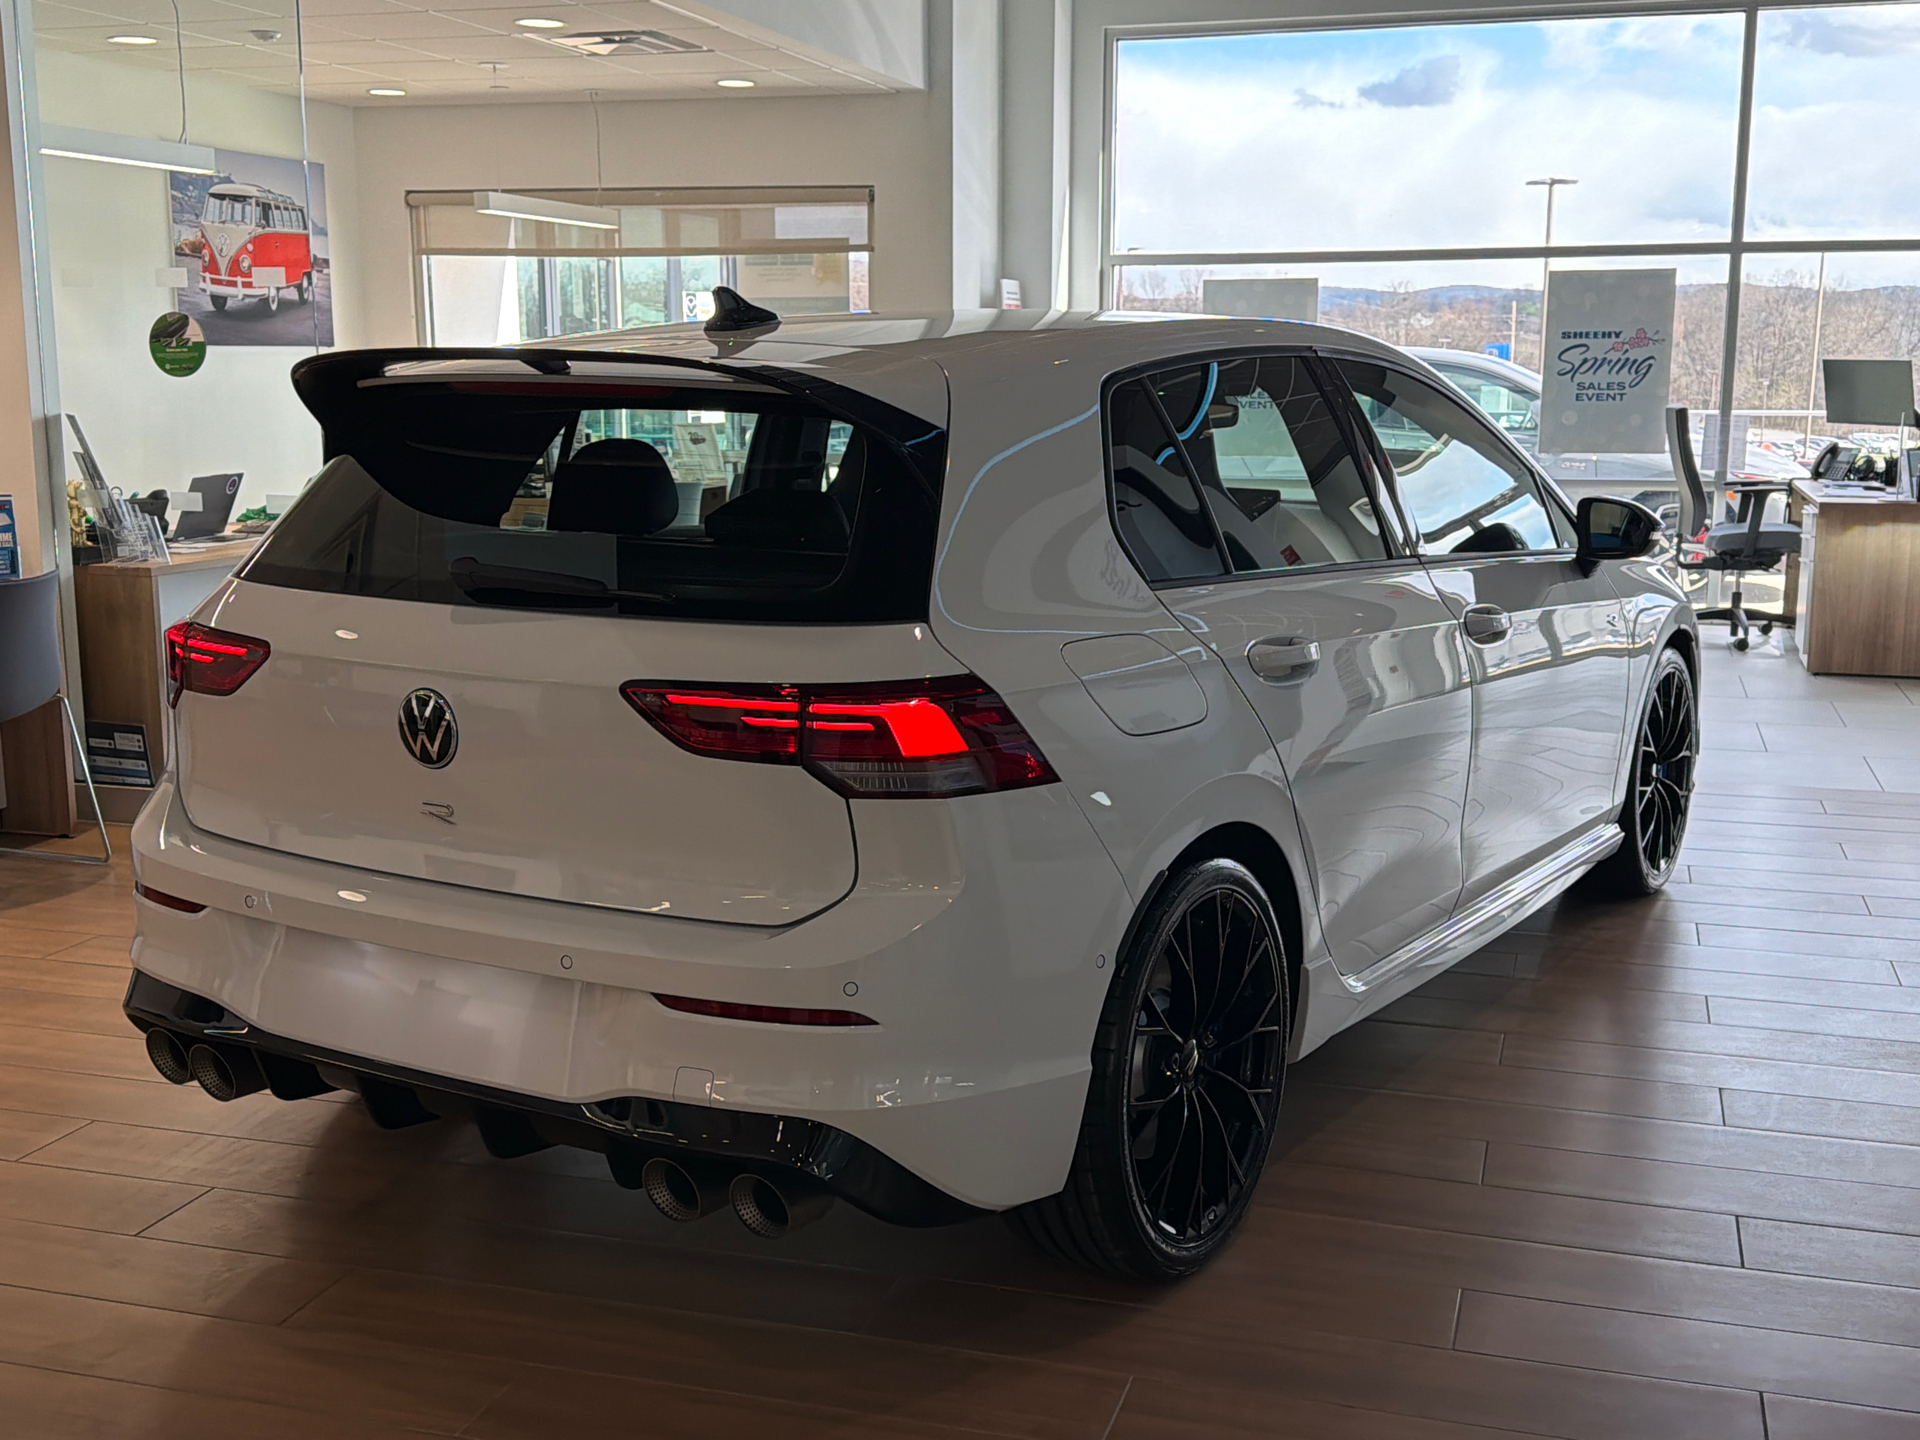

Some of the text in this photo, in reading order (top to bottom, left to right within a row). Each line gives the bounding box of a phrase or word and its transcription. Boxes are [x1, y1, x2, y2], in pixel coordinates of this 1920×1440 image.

[1561, 331, 1623, 339] SHEEHY
[1557, 343, 1656, 389] Spring
[1576, 382, 1626, 391] SALES
[1575, 393, 1627, 401] EVENT
[1239, 401, 1273, 409] VENT
[399, 690, 456, 766] VW
